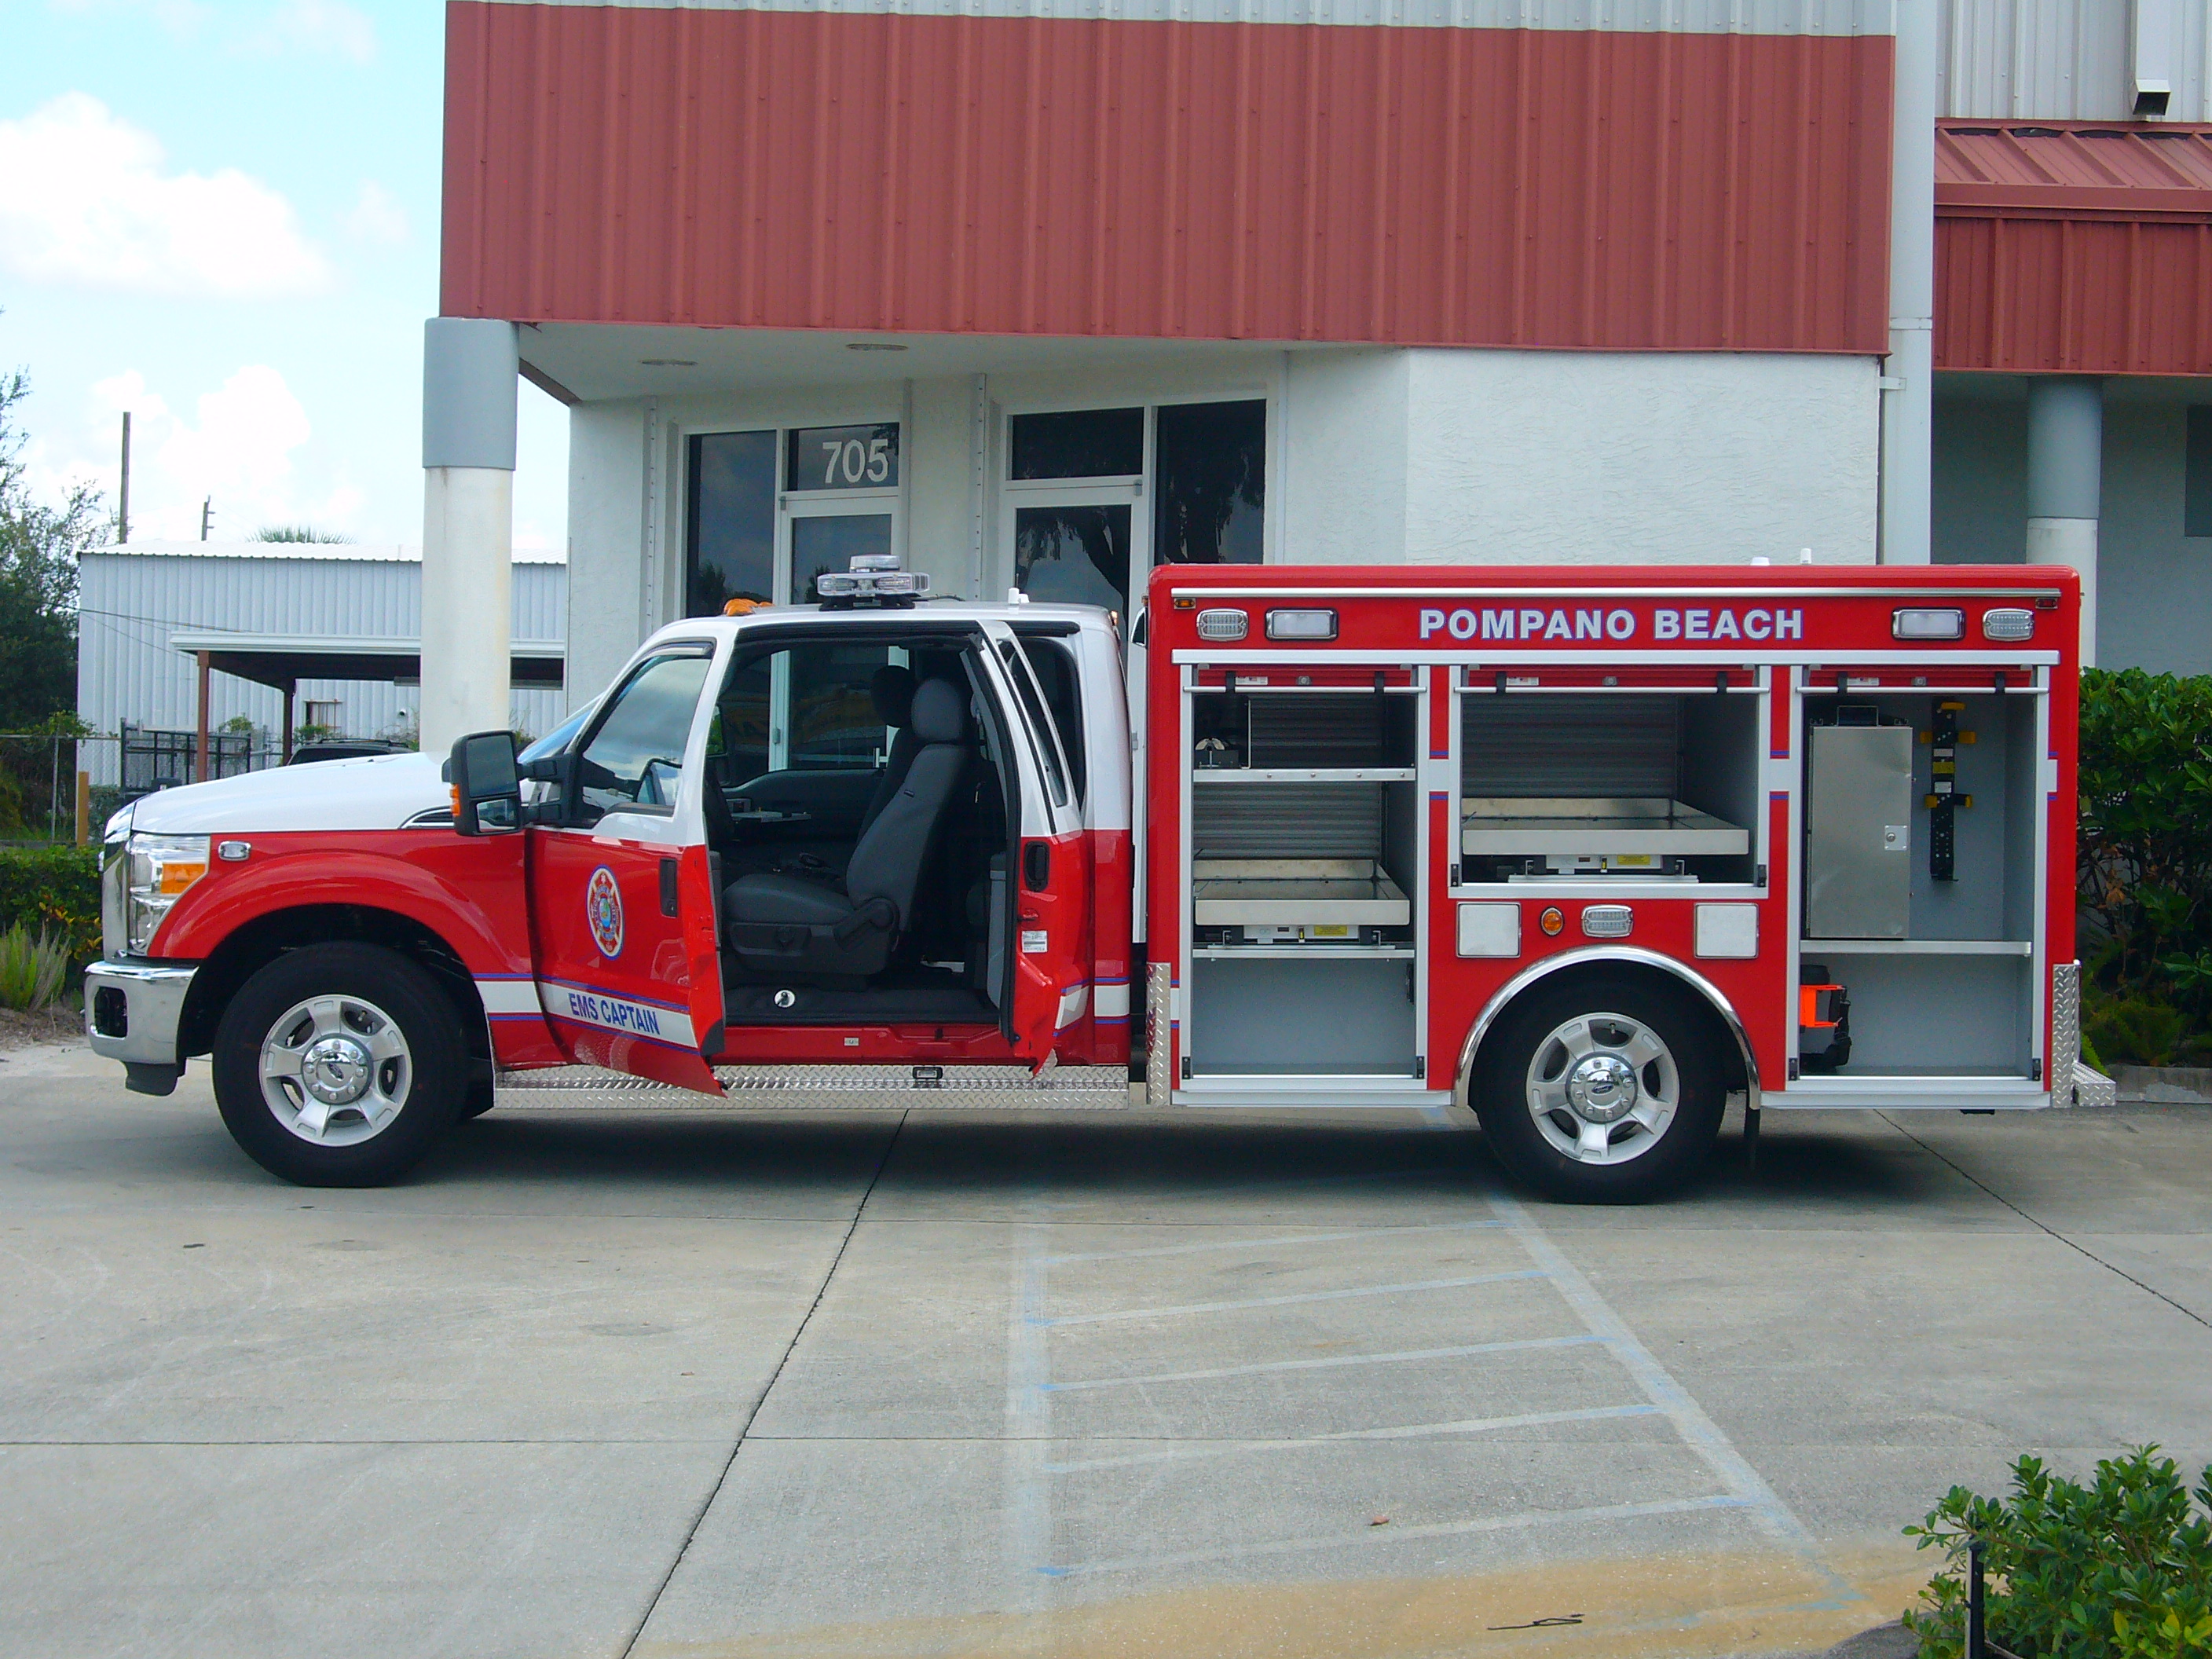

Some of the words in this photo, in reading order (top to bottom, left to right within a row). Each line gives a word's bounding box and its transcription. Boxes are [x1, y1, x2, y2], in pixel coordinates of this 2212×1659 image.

[822, 439, 888, 483] 705
[1419, 609, 1635, 639] POMPANO
[1654, 609, 1803, 639] BEACH
[568, 992, 599, 1020] EMS
[600, 999, 660, 1035] CAPTAIN
